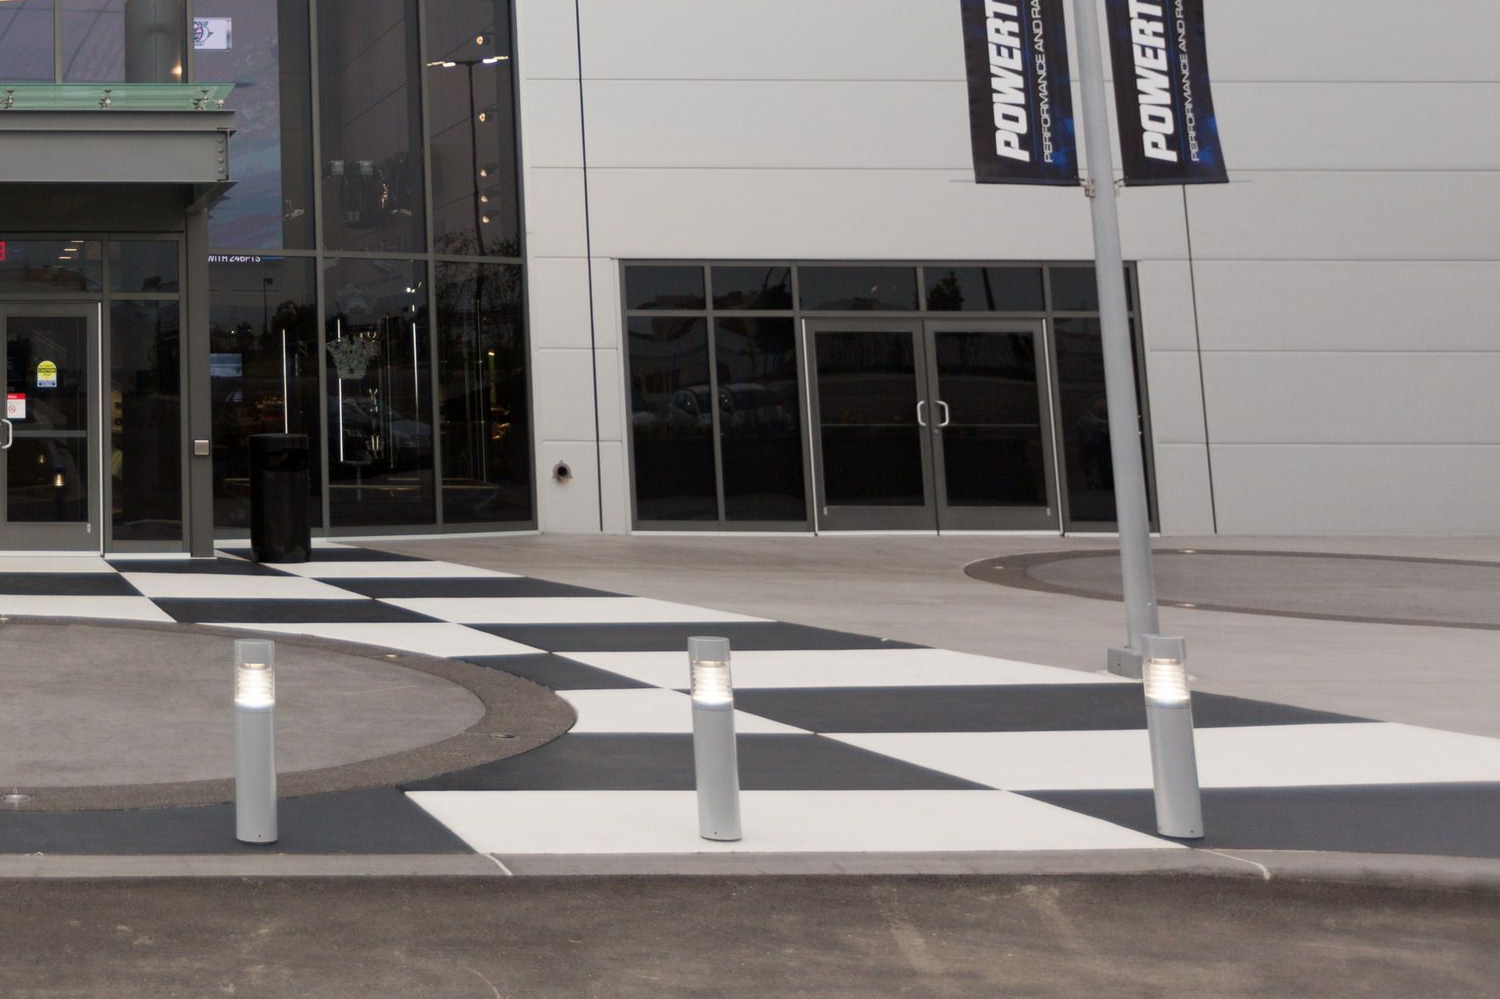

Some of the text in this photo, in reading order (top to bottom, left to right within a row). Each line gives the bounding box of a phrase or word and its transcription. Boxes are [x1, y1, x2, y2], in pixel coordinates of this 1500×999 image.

[1032, 20, 1044, 52] AND
[1177, 20, 1187, 52] AND
[1035, 54, 1053, 163] PERFORMANCE
[1180, 54, 1200, 162] PERFORMANCE
